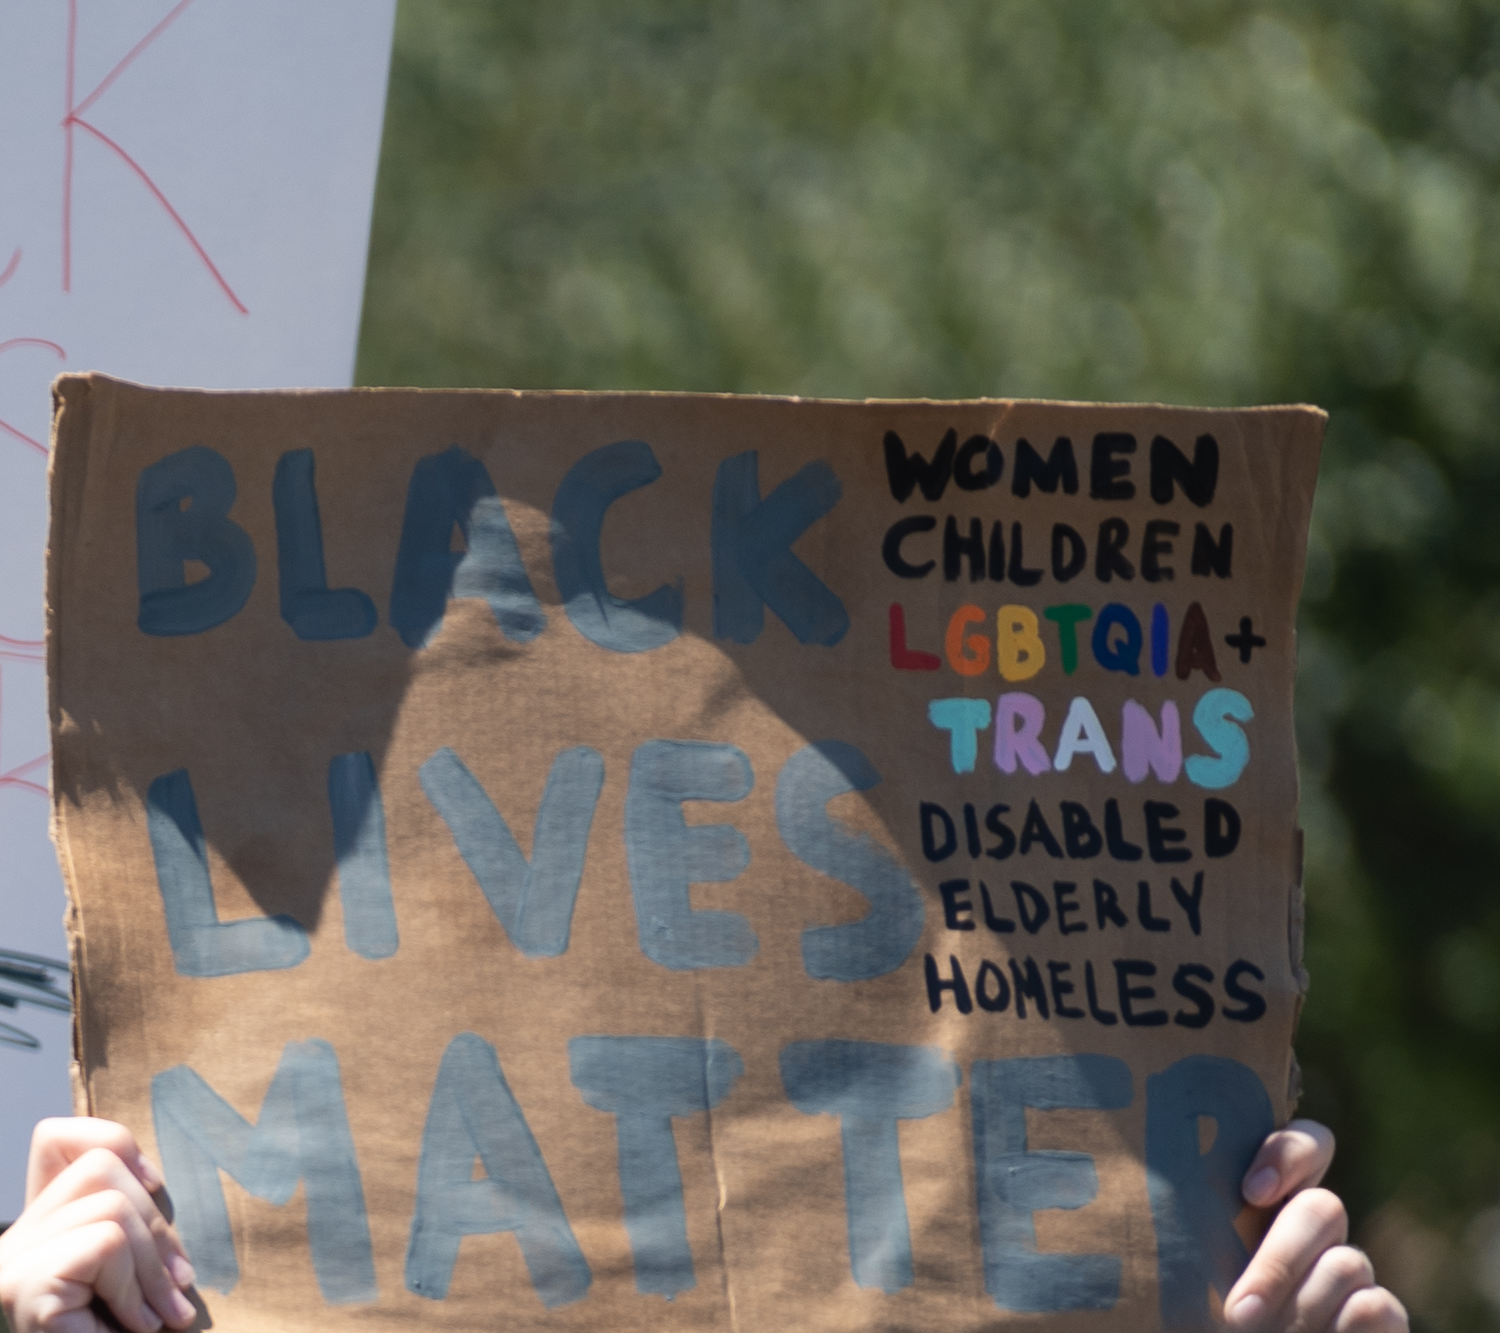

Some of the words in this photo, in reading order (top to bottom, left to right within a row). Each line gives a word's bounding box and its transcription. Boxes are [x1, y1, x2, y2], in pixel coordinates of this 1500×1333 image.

[882, 427, 1221, 507] WOMEN
[133, 438, 852, 656] BLACK
[881, 513, 1234, 587] CHILDREN
[888, 602, 1267, 683] LGBTQIA+
[927, 687, 1255, 789] TRANS
[145, 738, 926, 982] LIVES
[919, 798, 1242, 863] DISABLED
[938, 870, 1205, 936] ELDERLY
[923, 953, 1268, 1029] HOMELESS
[149, 1031, 1276, 1332] MATTER
